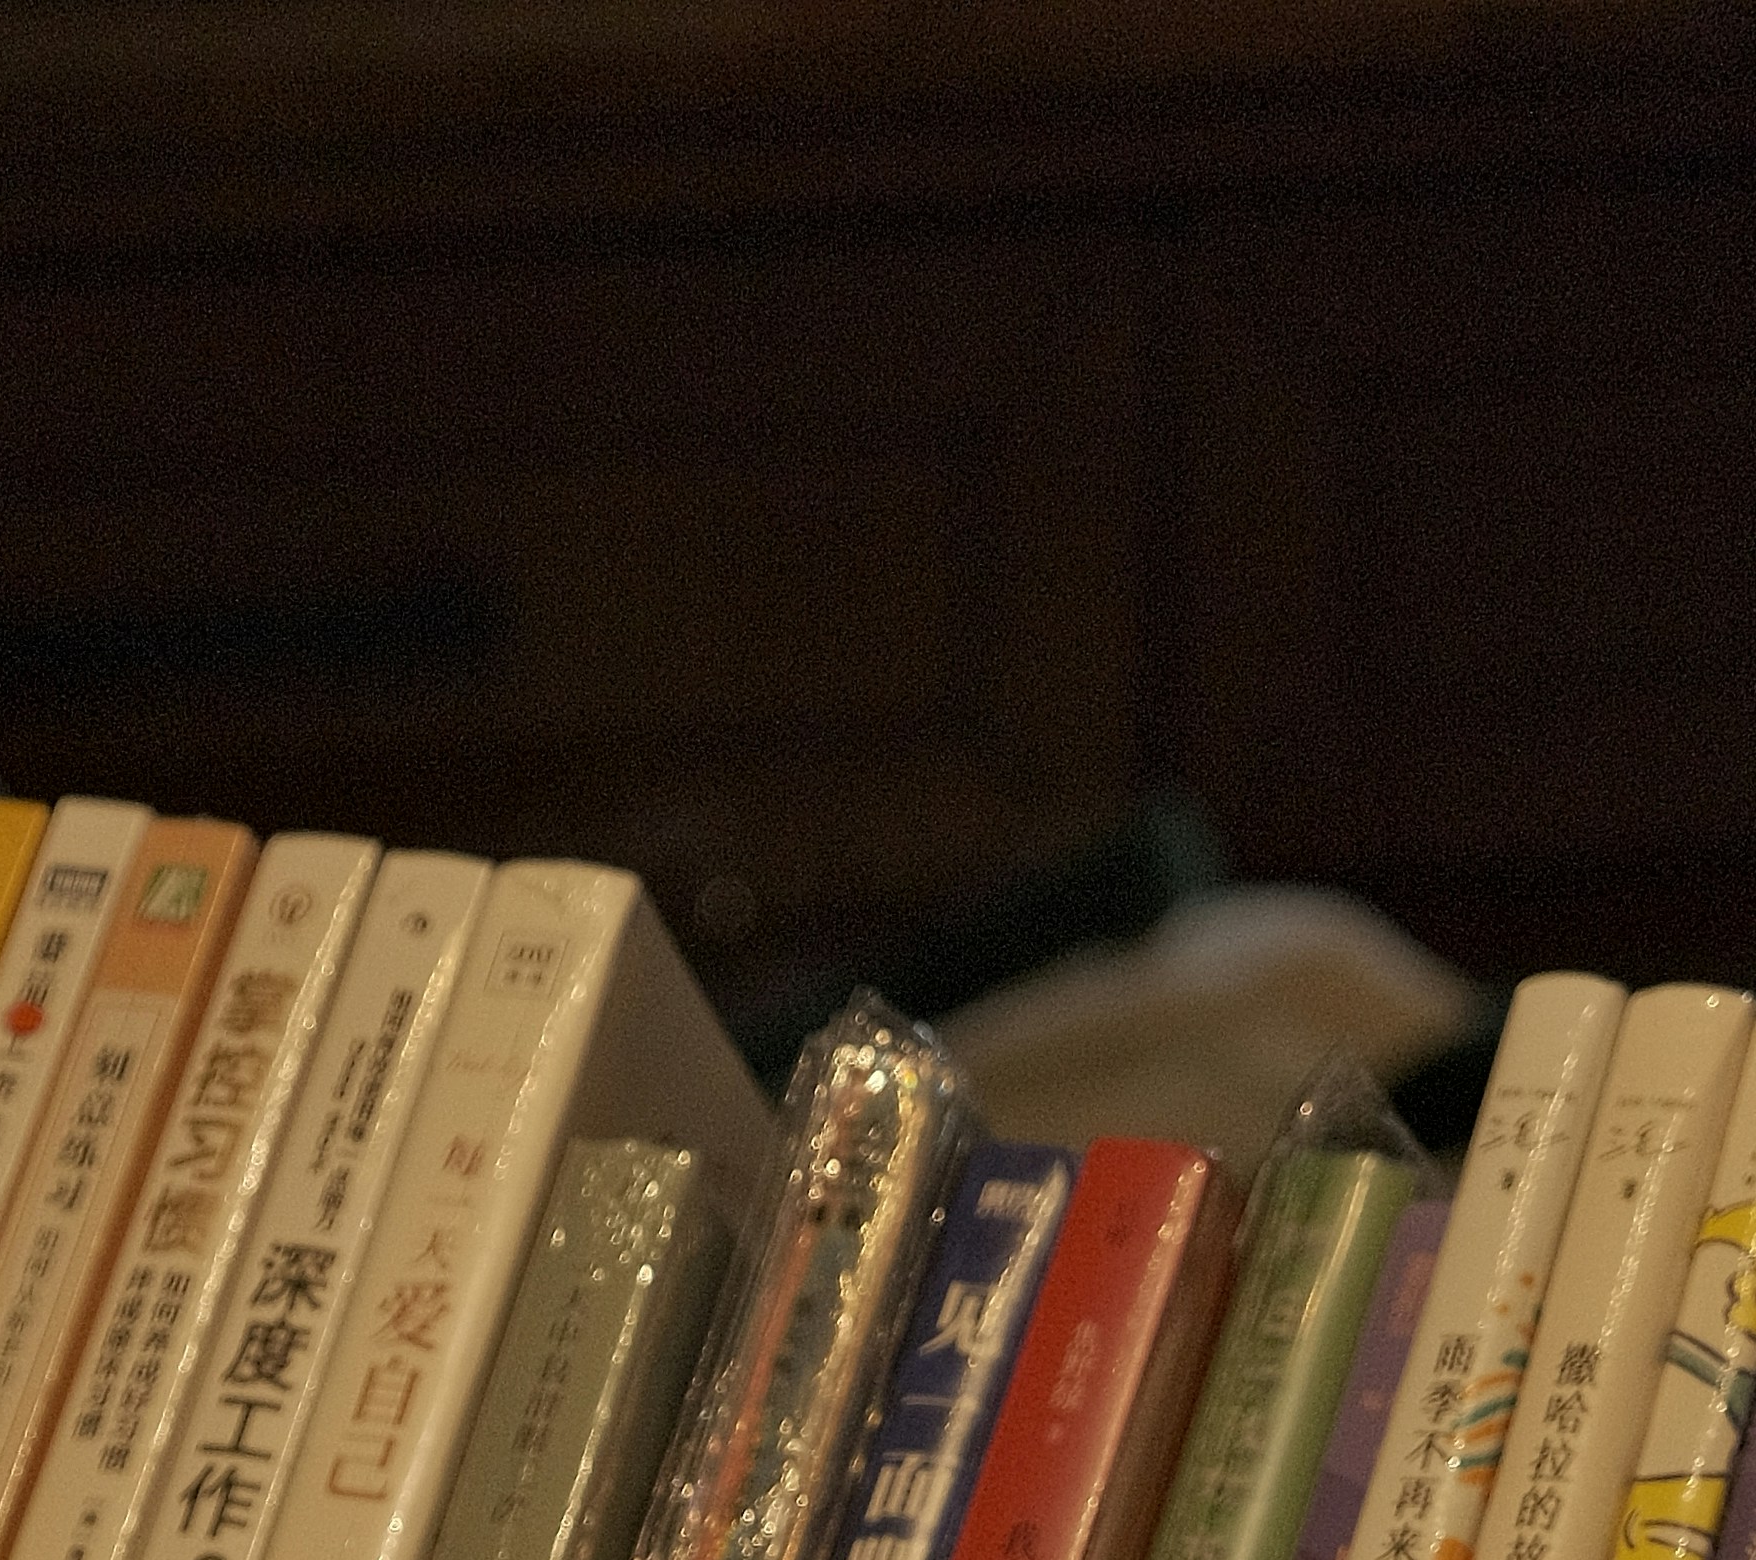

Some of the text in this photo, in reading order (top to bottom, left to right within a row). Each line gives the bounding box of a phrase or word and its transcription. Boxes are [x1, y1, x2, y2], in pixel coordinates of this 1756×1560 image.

[49, 1045, 134, 1210] 刻意练习
[145, 969, 289, 1254] 掌控习惯
[99, 1274, 191, 1472] 如何养成好习惯
[180, 1241, 336, 1538] 深度工作
